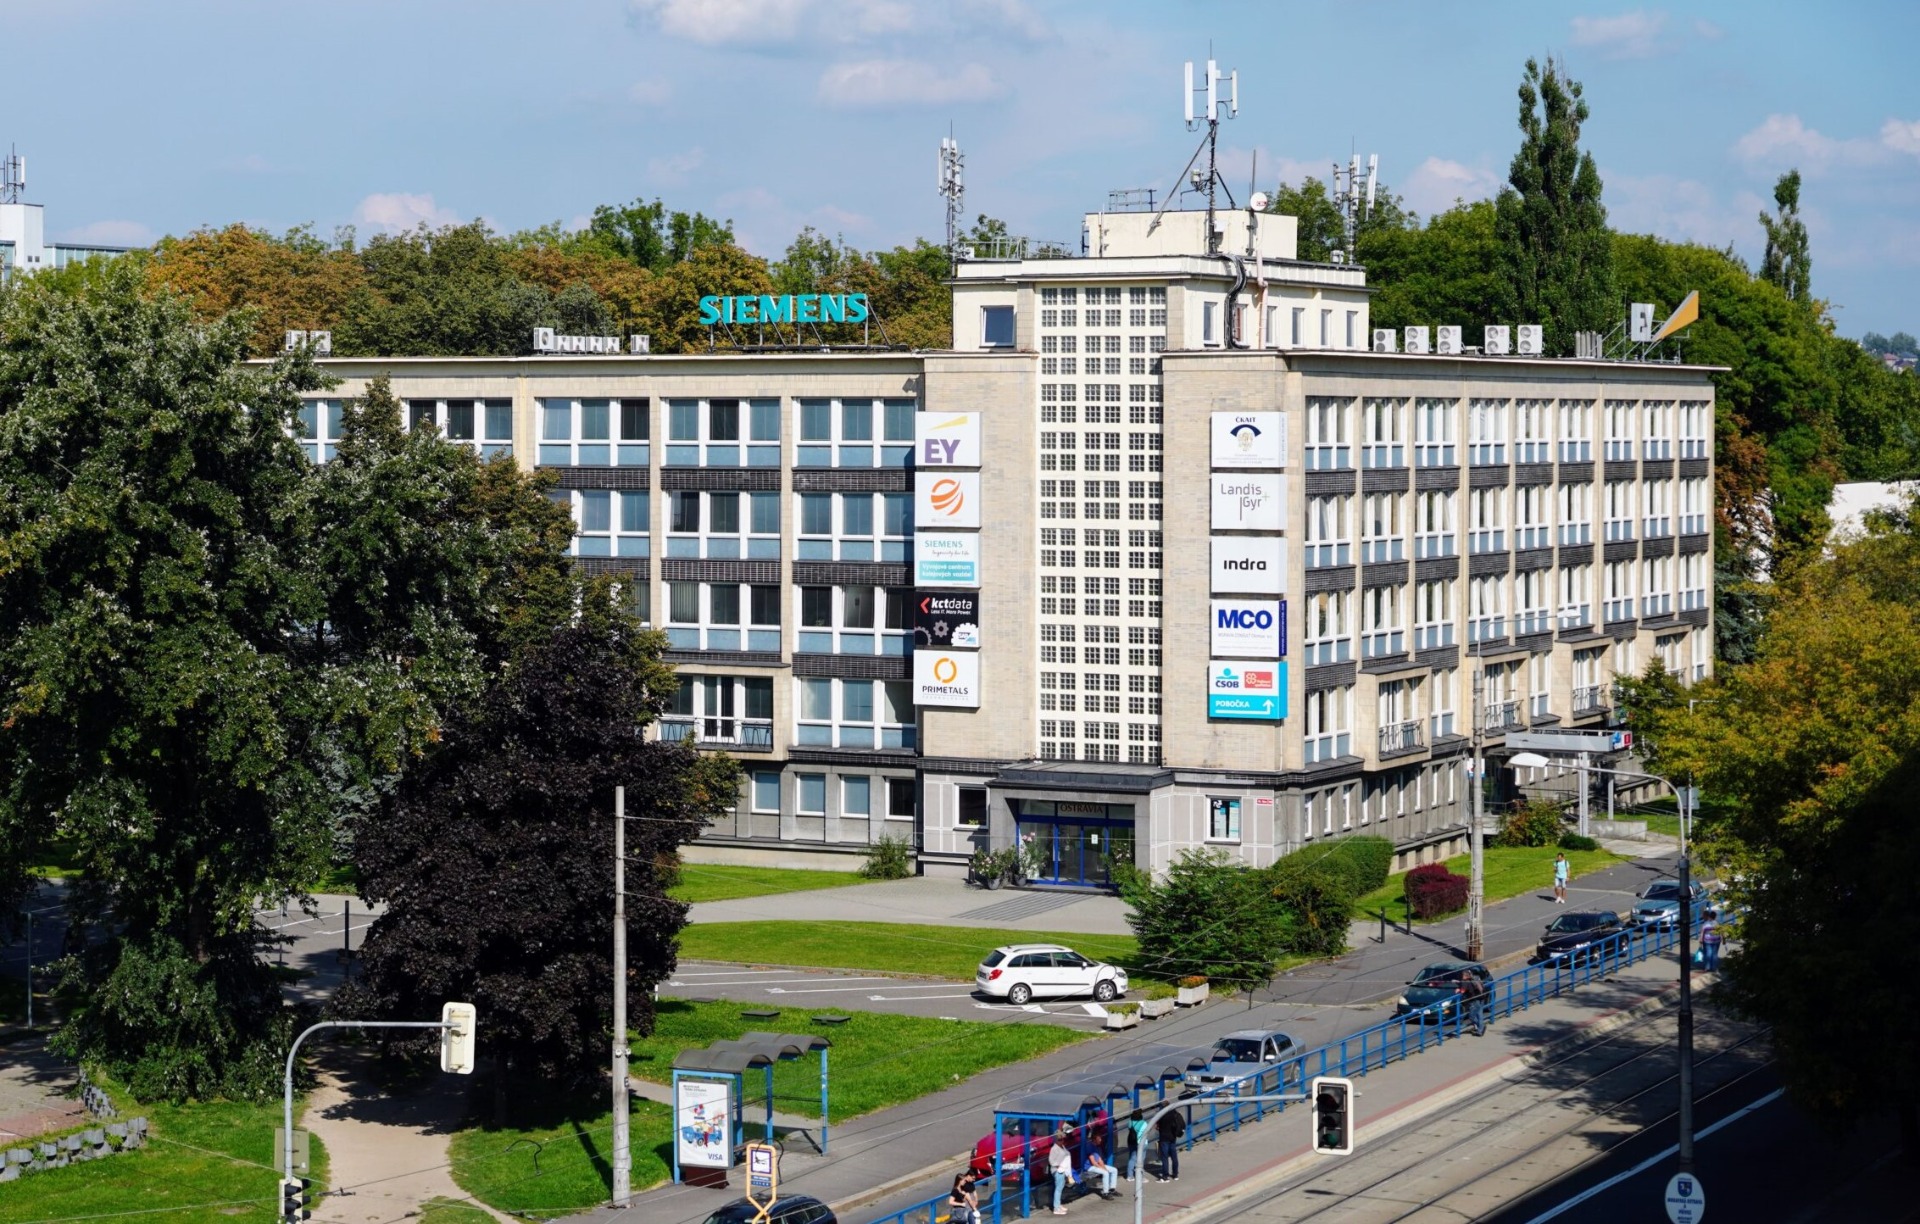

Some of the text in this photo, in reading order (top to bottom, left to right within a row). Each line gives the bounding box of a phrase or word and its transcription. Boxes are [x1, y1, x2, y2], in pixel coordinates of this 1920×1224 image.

[699, 293, 868, 325] SIEMENS
[924, 438, 961, 464] EY
[1220, 483, 1262, 496] Landis
[924, 540, 963, 548] SIEMENS
[1223, 558, 1267, 571] indra
[931, 597, 973, 610] kctdata
[1218, 609, 1273, 630] MCO
[1215, 680, 1239, 688] ČSOB
[922, 685, 969, 695] PRIMETALS
[1215, 699, 1250, 708] POBOČKA
[1060, 803, 1103, 813] OSTRAVIA
[708, 1153, 723, 1161] VISA
